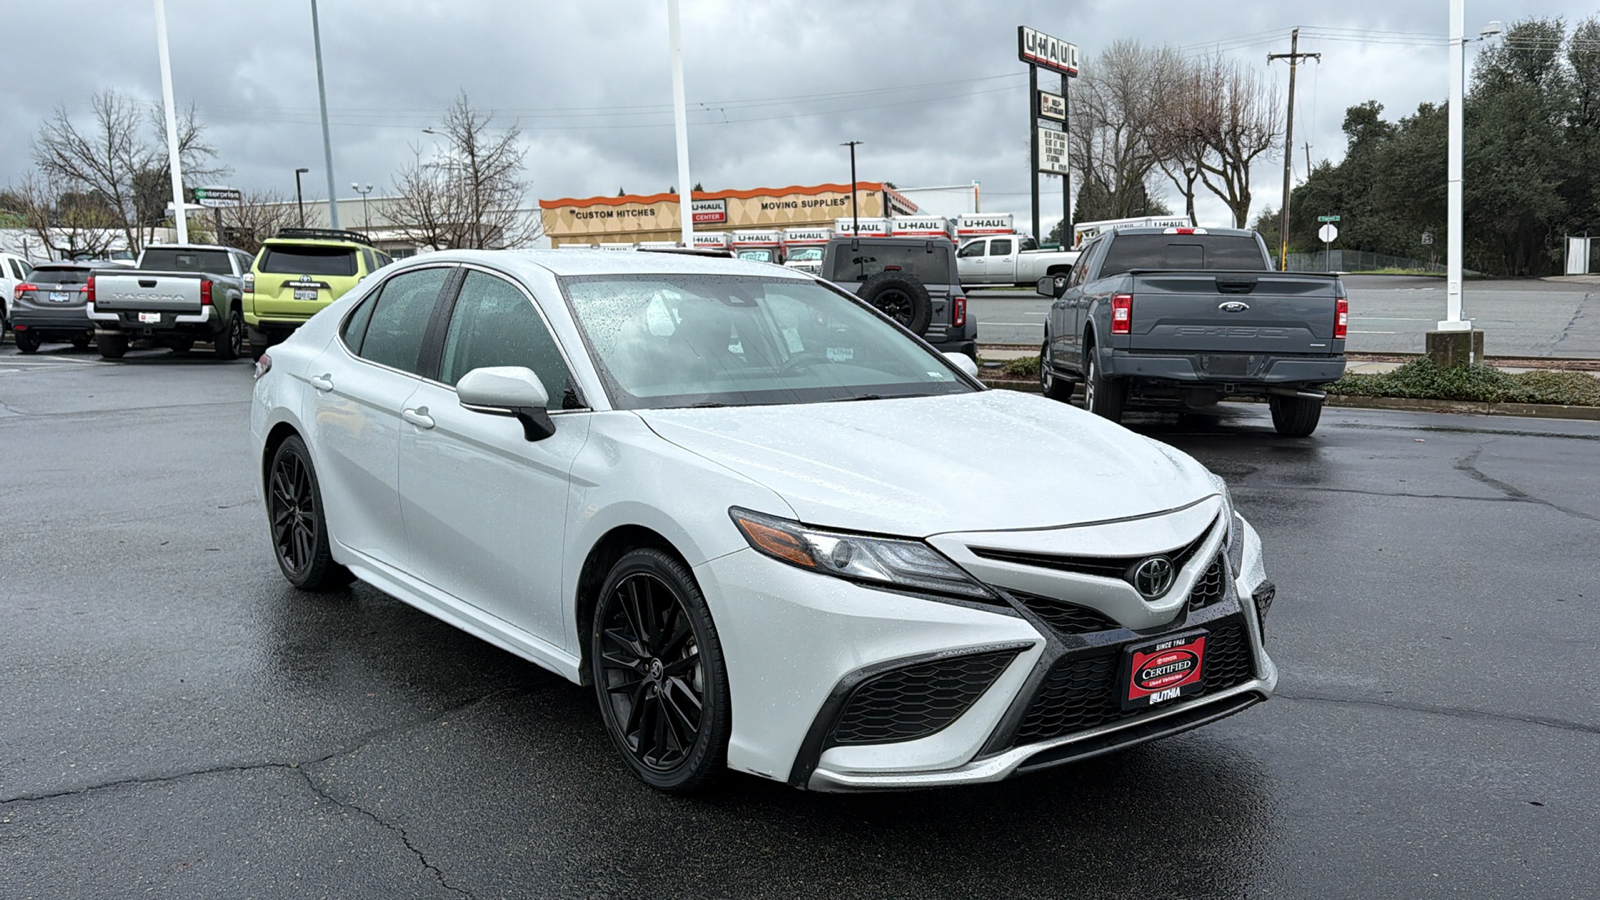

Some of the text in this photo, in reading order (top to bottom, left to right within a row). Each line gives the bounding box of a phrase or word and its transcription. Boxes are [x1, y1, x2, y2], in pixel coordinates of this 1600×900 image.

[1026, 31, 1078, 67] U-HAUL
[761, 198, 846, 211] MOVING SUPPLIES
[575, 208, 655, 219] CUSTOM HITCHES
[964, 219, 1007, 227] U-HAUL
[112, 292, 184, 300] TACOMA
[1156, 641, 1172, 651] SINCE
[1161, 655, 1177, 663] TOYOTA
[1142, 660, 1191, 680] CERTIFIED
[1149, 674, 1182, 687] Used Vehicles
[1156, 687, 1180, 702] LITHIA
